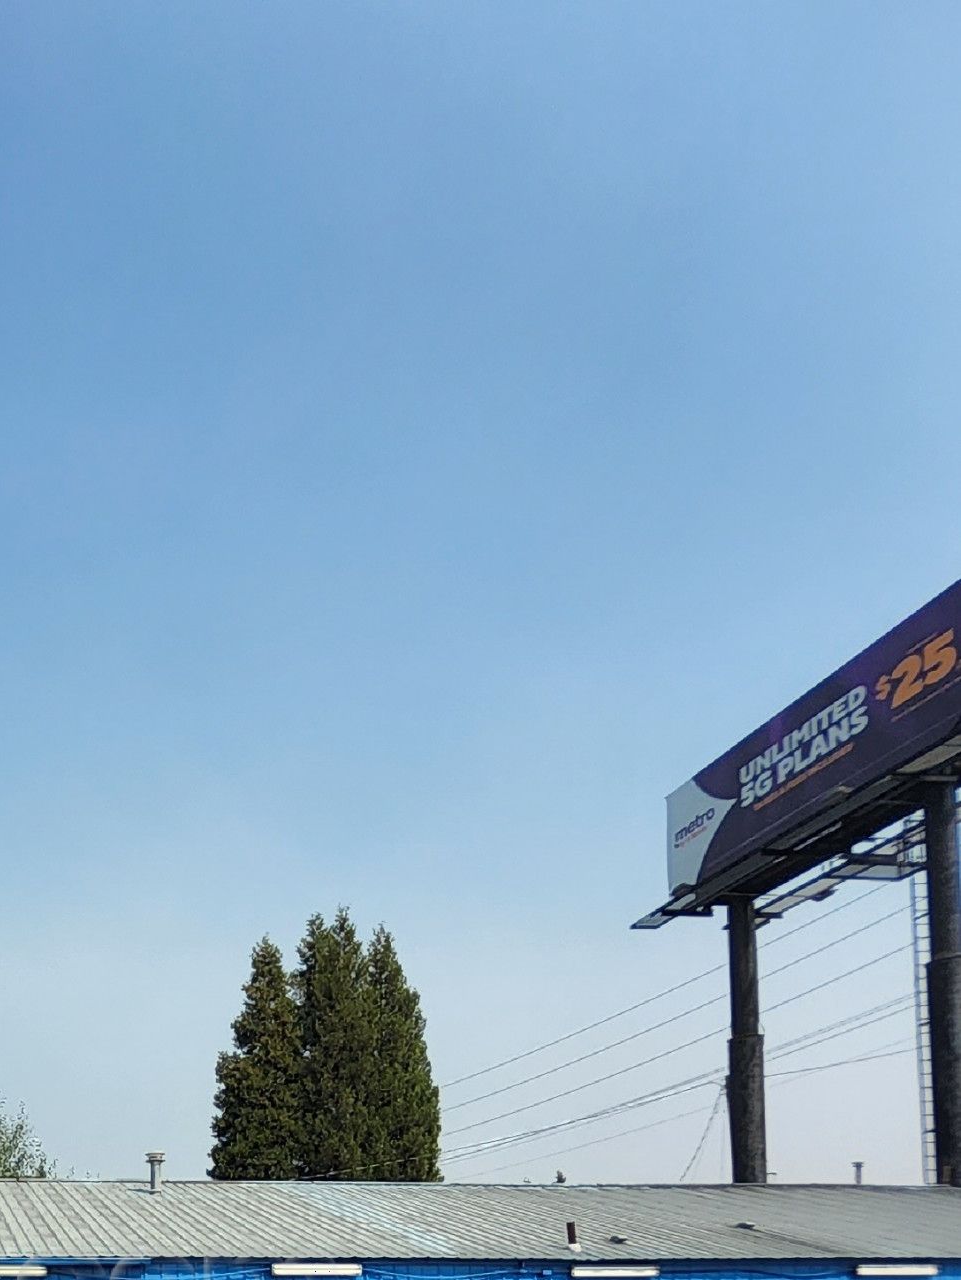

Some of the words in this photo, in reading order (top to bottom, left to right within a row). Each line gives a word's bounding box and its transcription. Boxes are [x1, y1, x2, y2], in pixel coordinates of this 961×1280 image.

[874, 628, 957, 709] $25
[739, 685, 867, 783] UNLIMITED
[740, 770, 773, 808] 5G
[776, 705, 869, 784] PLANS
[674, 807, 715, 842] metro
